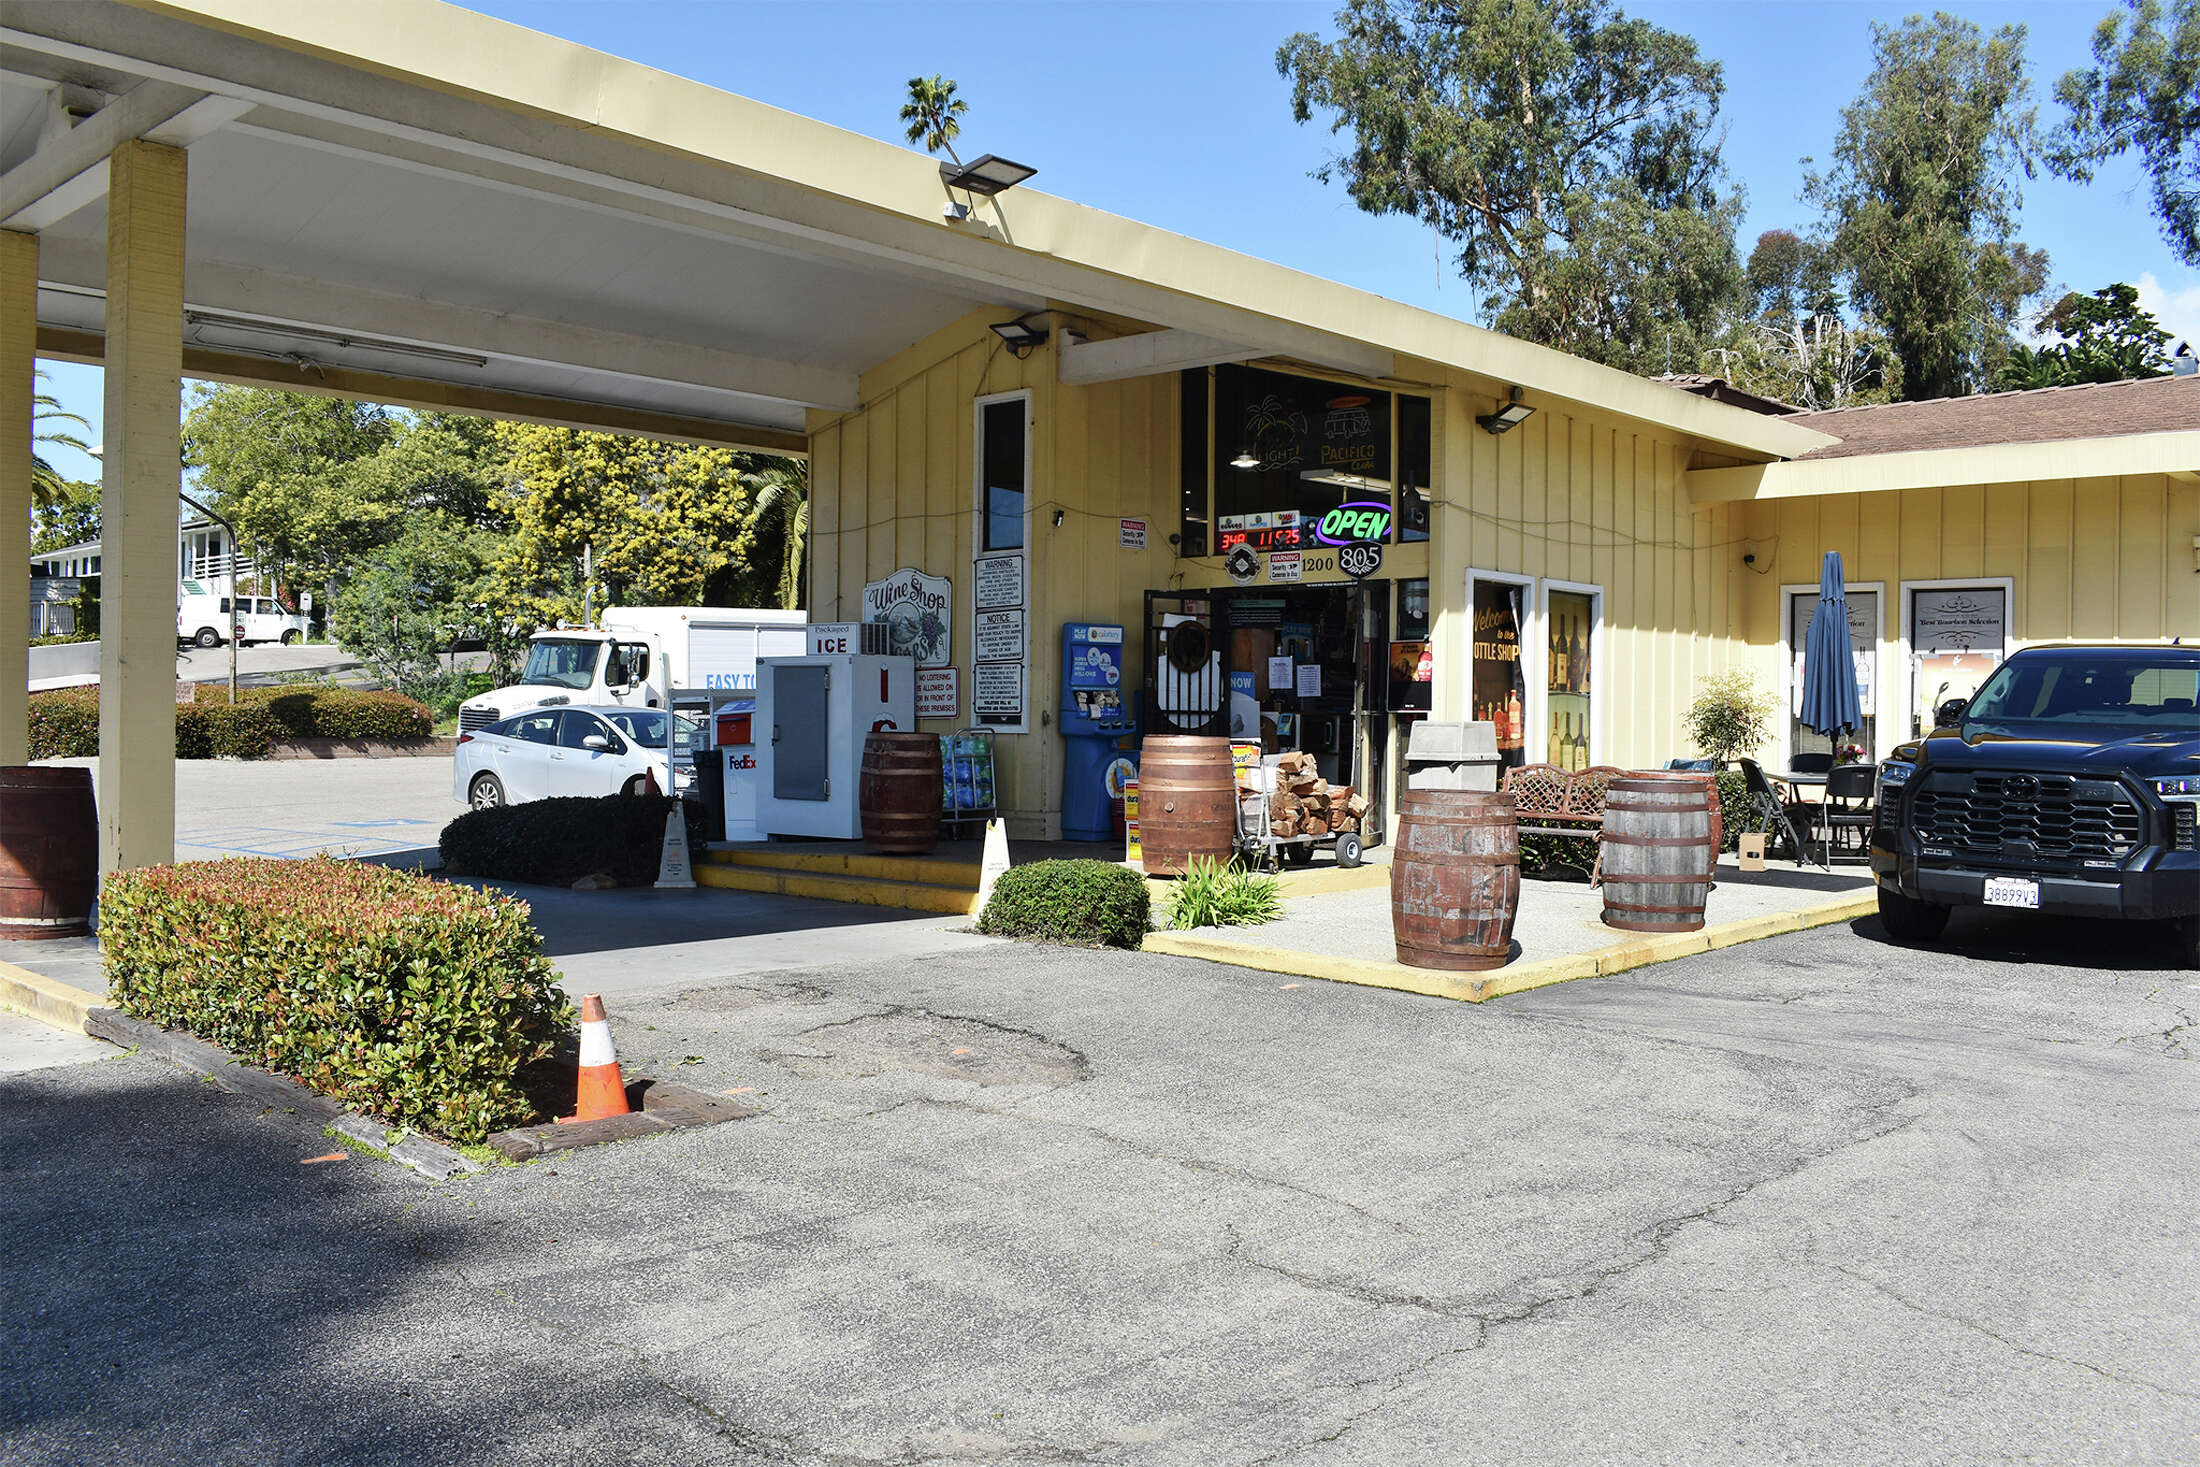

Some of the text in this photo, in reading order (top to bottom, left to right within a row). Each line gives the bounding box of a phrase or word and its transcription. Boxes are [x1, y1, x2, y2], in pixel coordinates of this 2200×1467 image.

[1321, 444, 1375, 464] PACIFICO
[1322, 509, 1390, 539] OPEN
[985, 559, 1013, 568] WARNING
[1271, 554, 1299, 562] WARNING
[1302, 558, 1333, 572] 1200
[1341, 547, 1380, 569] 805
[869, 575, 947, 616] Wine Shop
[986, 613, 1010, 623] NOTICE
[815, 625, 849, 633] Packaged
[817, 637, 848, 653] ICE
[1474, 642, 1519, 661] OTTLE SHOP
[706, 674, 740, 689] EASY
[927, 673, 951, 681] LOITERING
[1231, 677, 1252, 689] NOW
[945, 683, 953, 691] ON
[729, 755, 756, 770] FedEx
[1988, 887, 2037, 904] 38899V3
